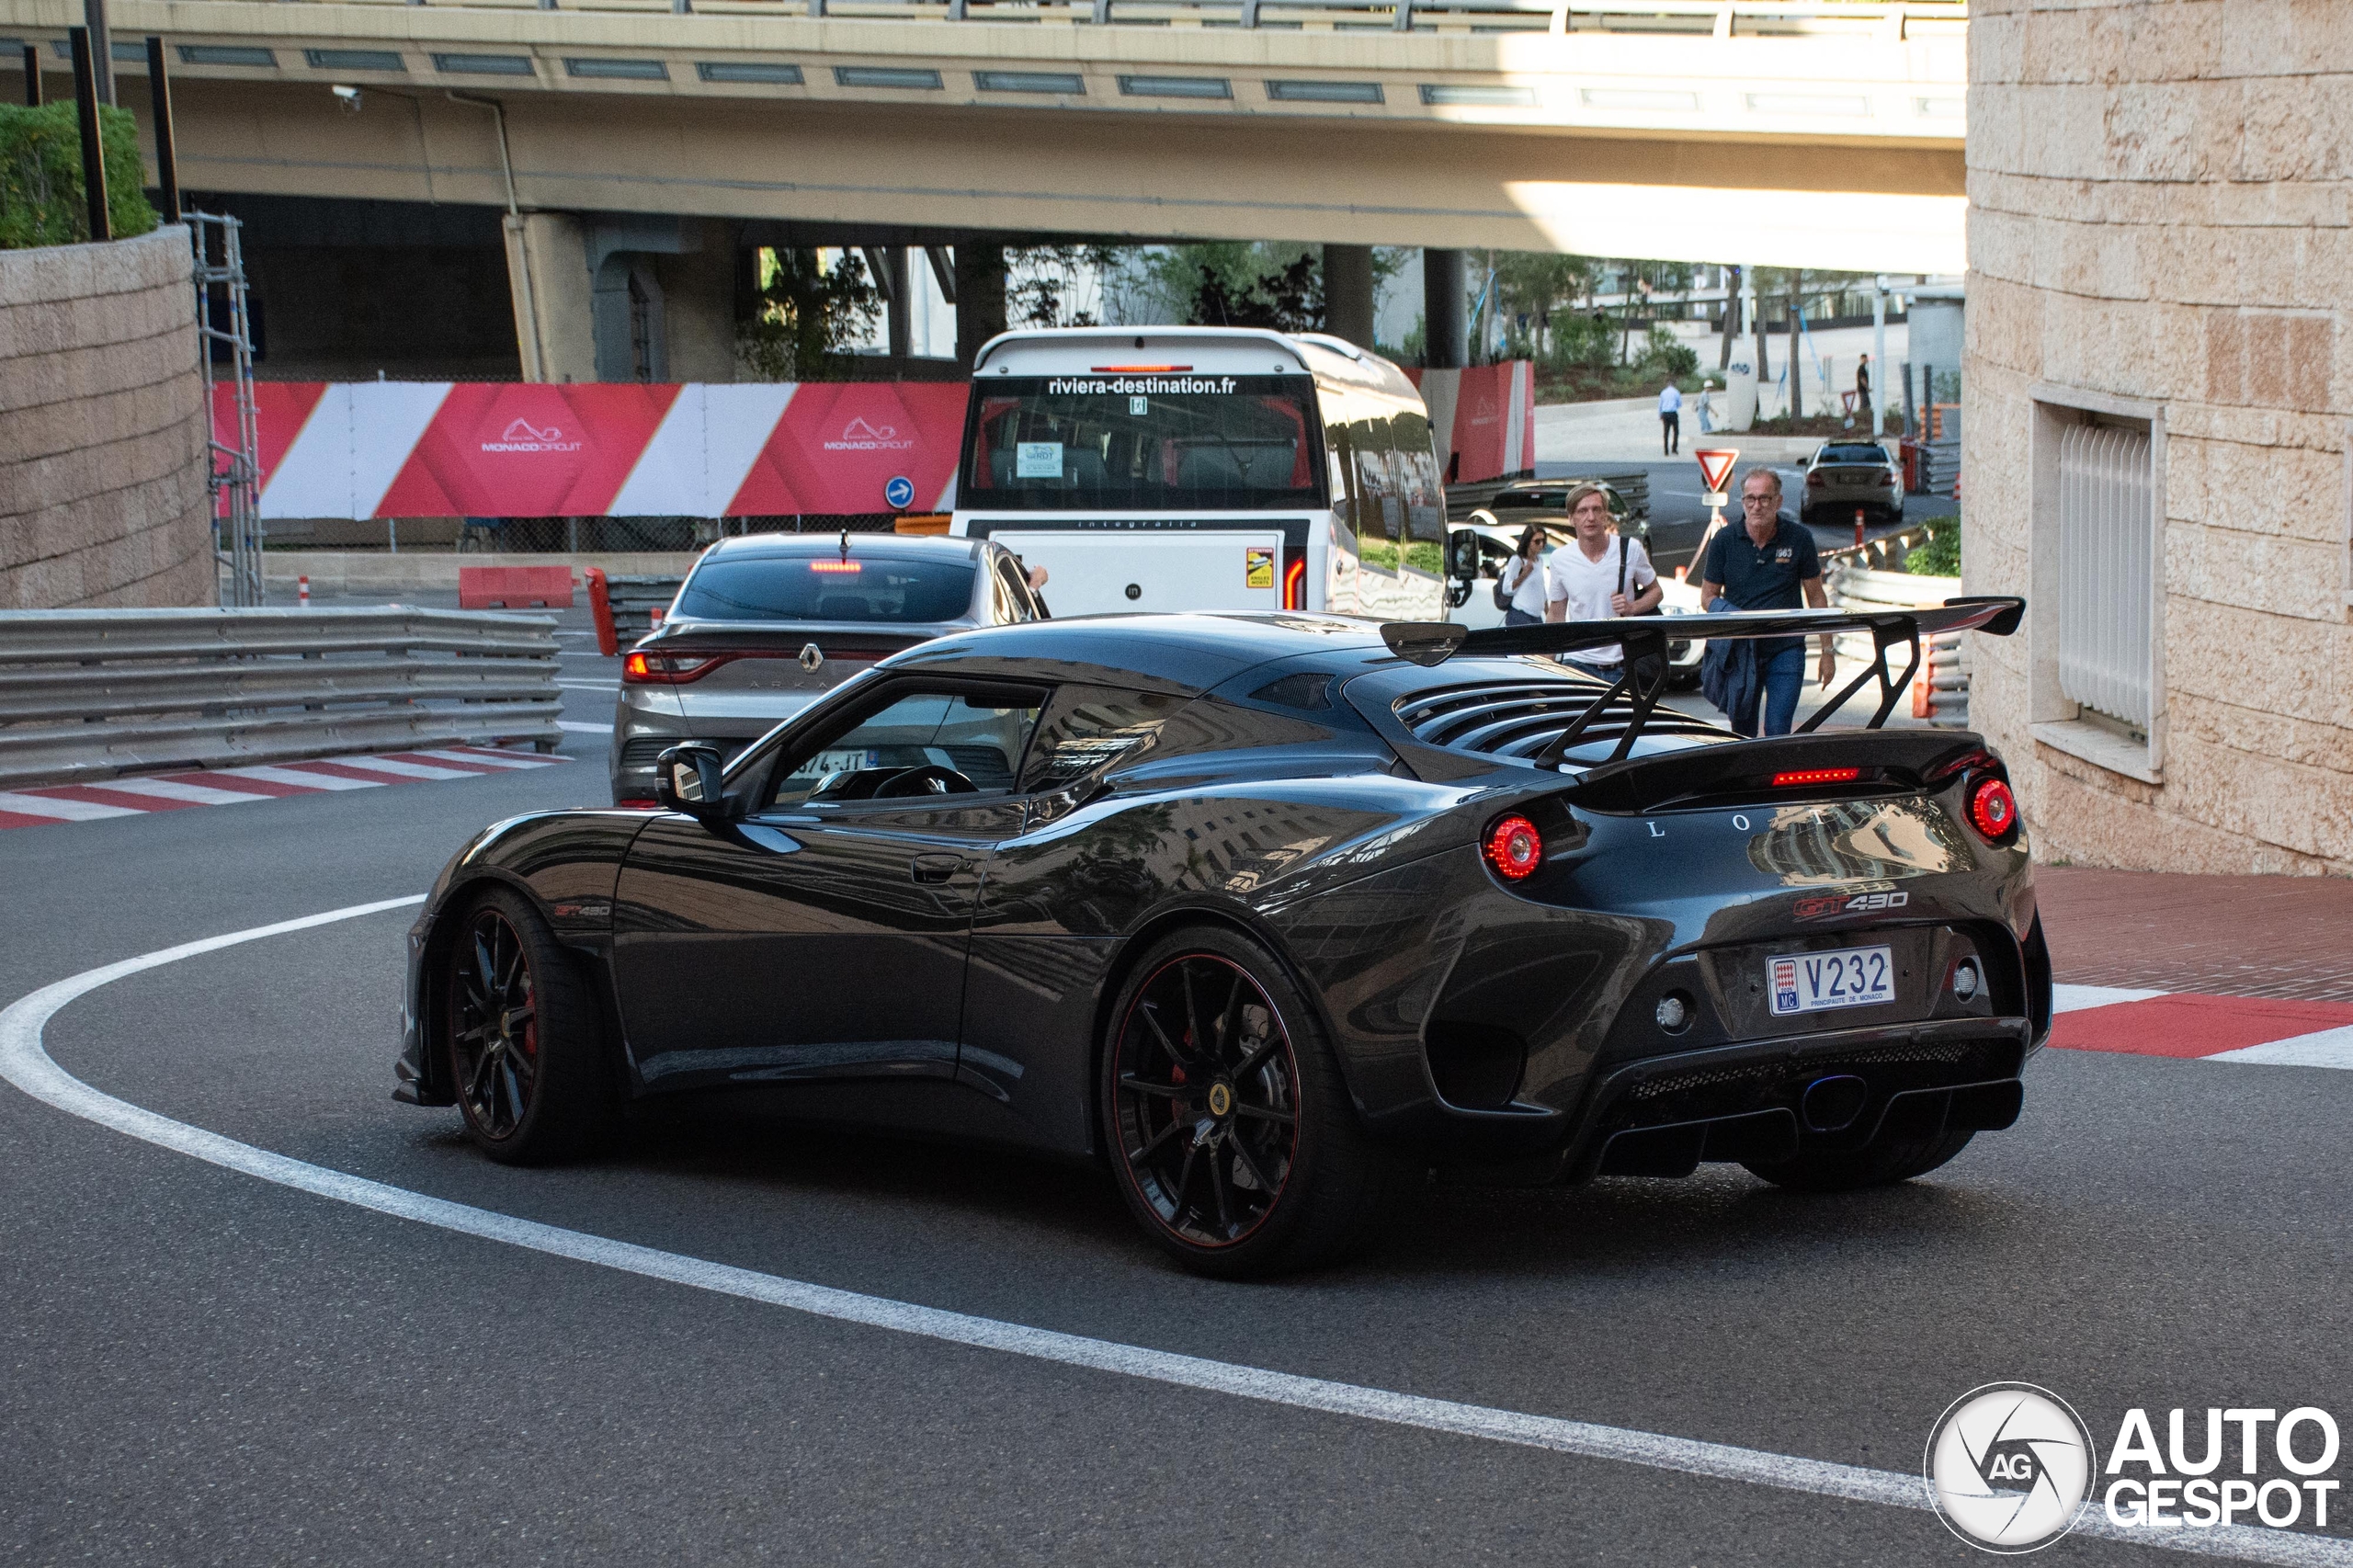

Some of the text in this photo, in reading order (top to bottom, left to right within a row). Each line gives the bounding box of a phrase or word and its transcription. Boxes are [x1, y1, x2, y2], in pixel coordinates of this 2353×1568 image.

[1049, 377, 1236, 394] riviera-destination.fr
[1646, 800, 1941, 838] LOTUS
[1805, 952, 1887, 998] V232
[1780, 994, 1794, 1007] MC
[1811, 998, 1846, 1006] PRINCIPAUTE
[1859, 993, 1883, 1001] MONACO
